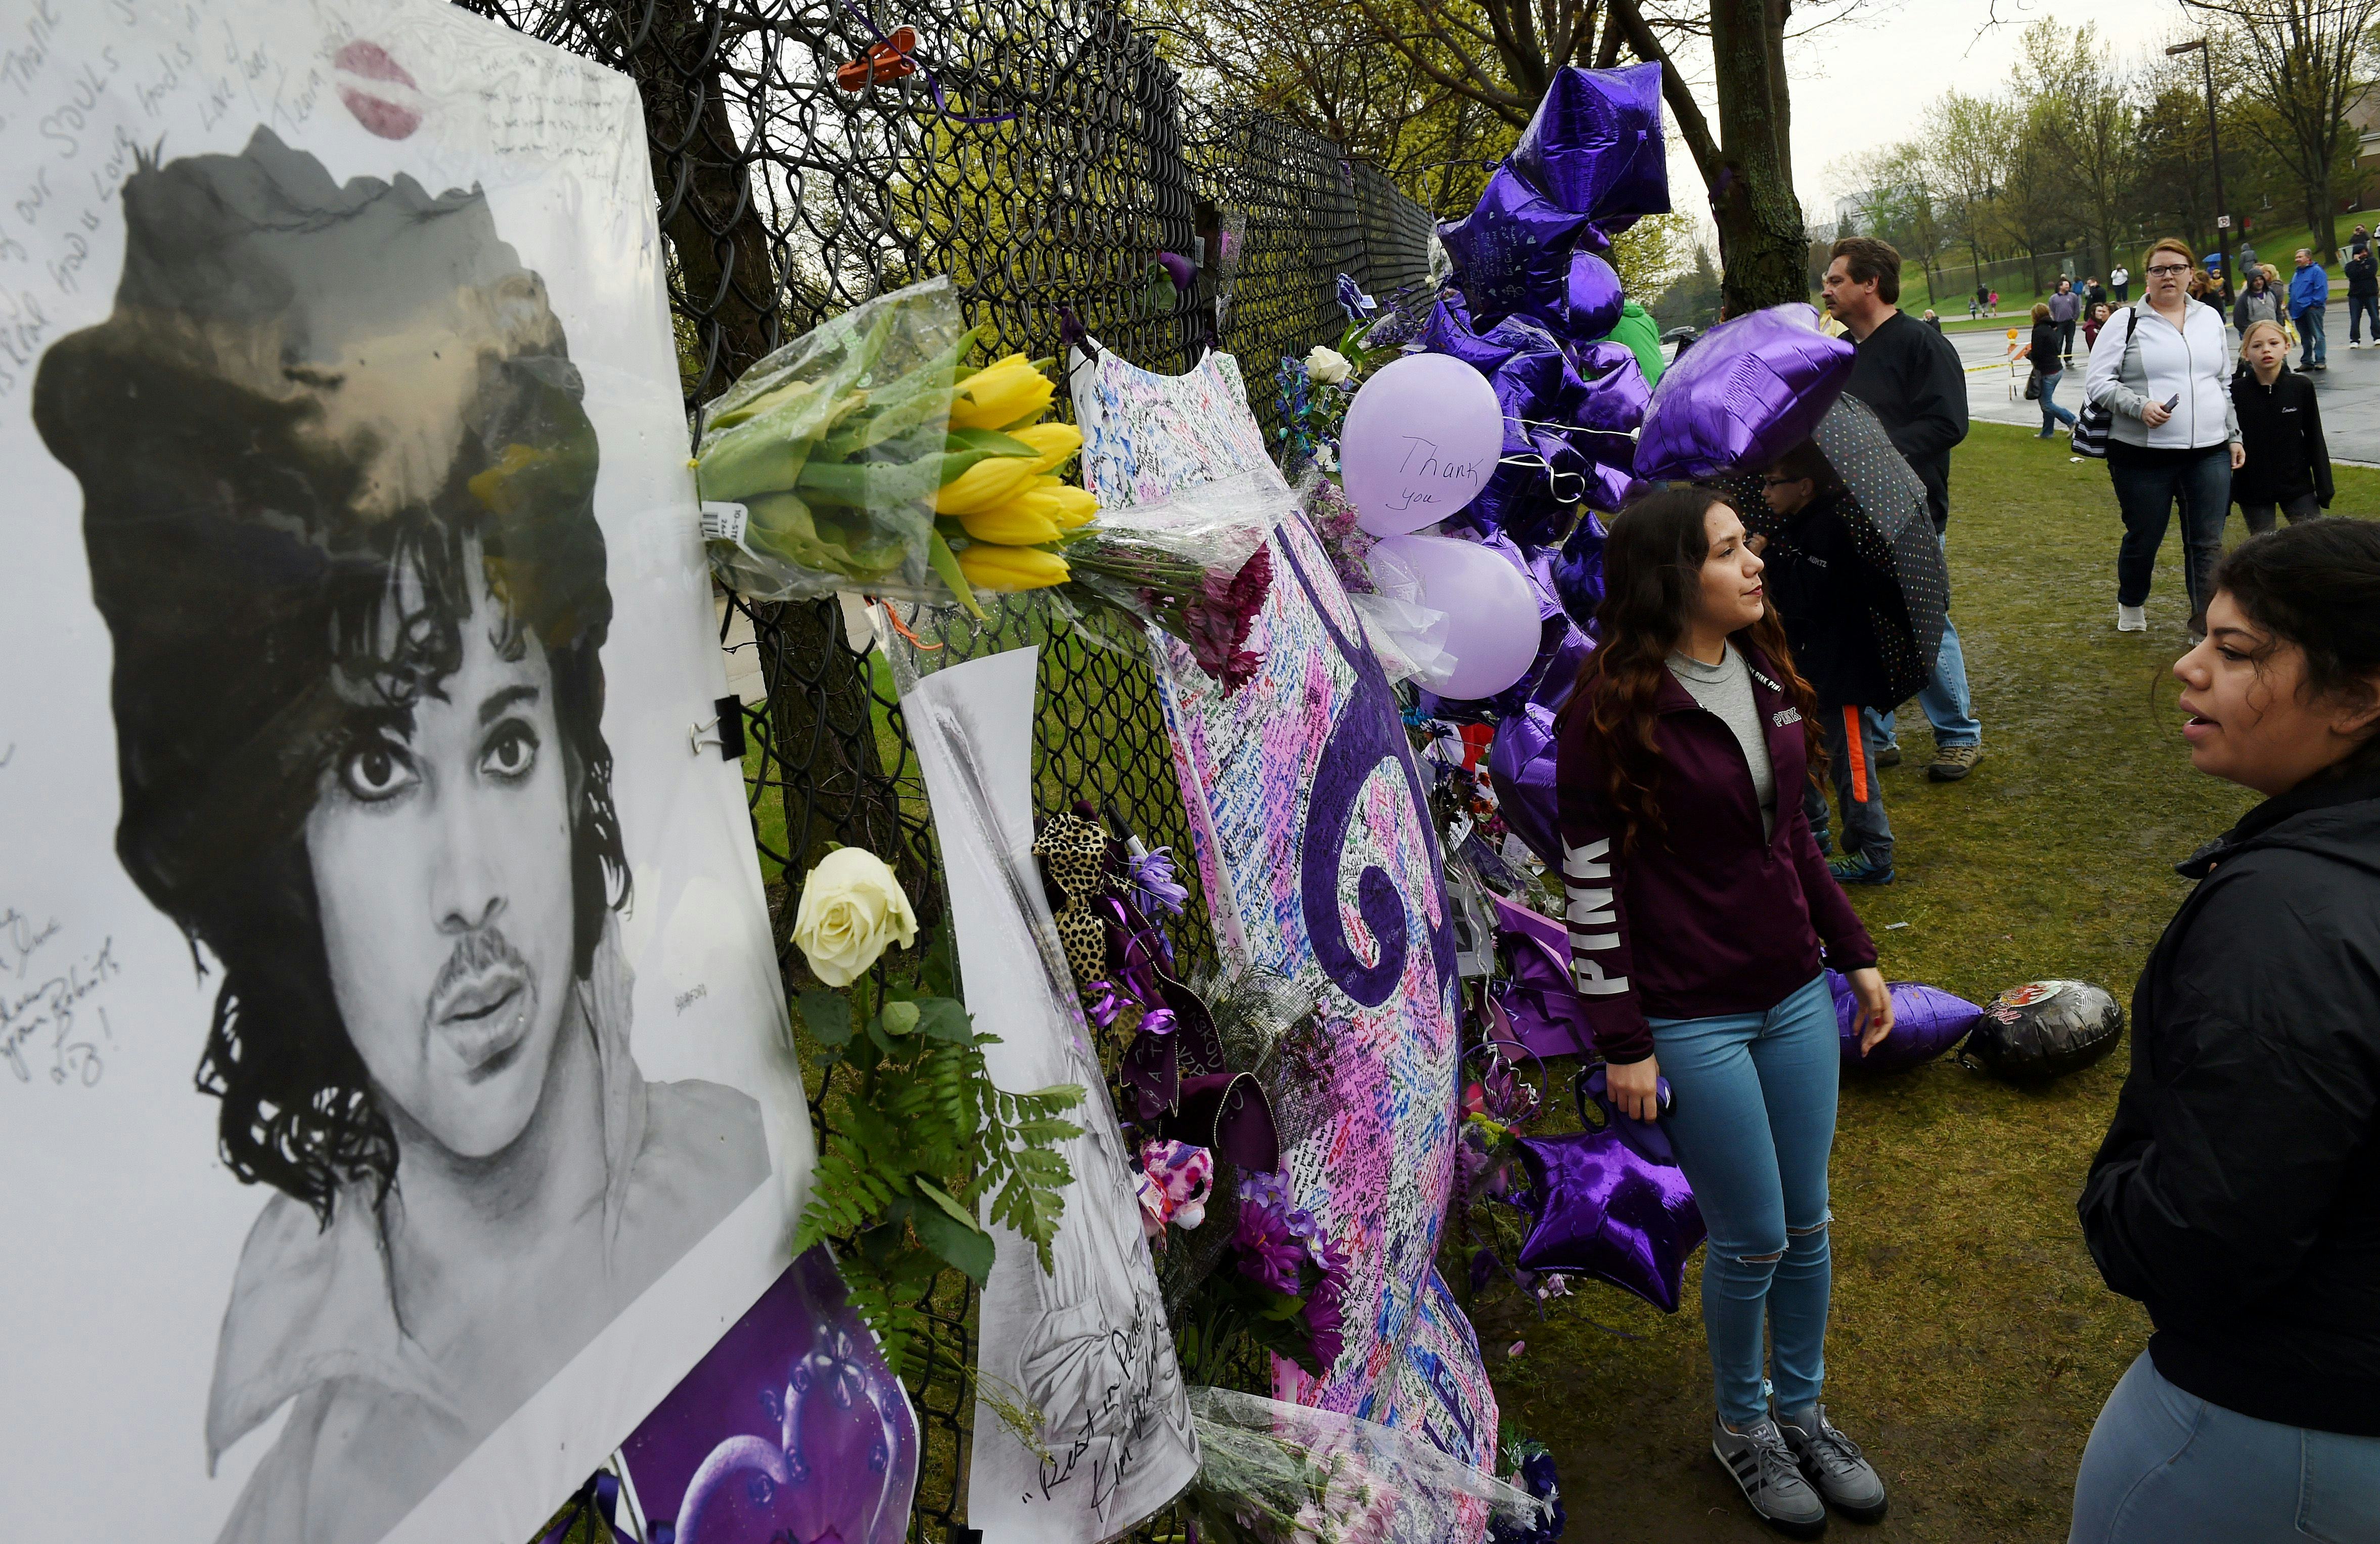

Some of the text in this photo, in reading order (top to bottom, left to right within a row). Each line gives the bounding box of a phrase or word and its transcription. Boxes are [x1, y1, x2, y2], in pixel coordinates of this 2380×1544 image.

[1400, 435, 1484, 487] Thank
[1385, 487, 1441, 510] you
[1772, 707, 1802, 727] PINK
[1560, 832, 1630, 995] PINK
[1111, 1281, 1144, 1381] Peace
[1103, 1382, 1121, 1415] in
